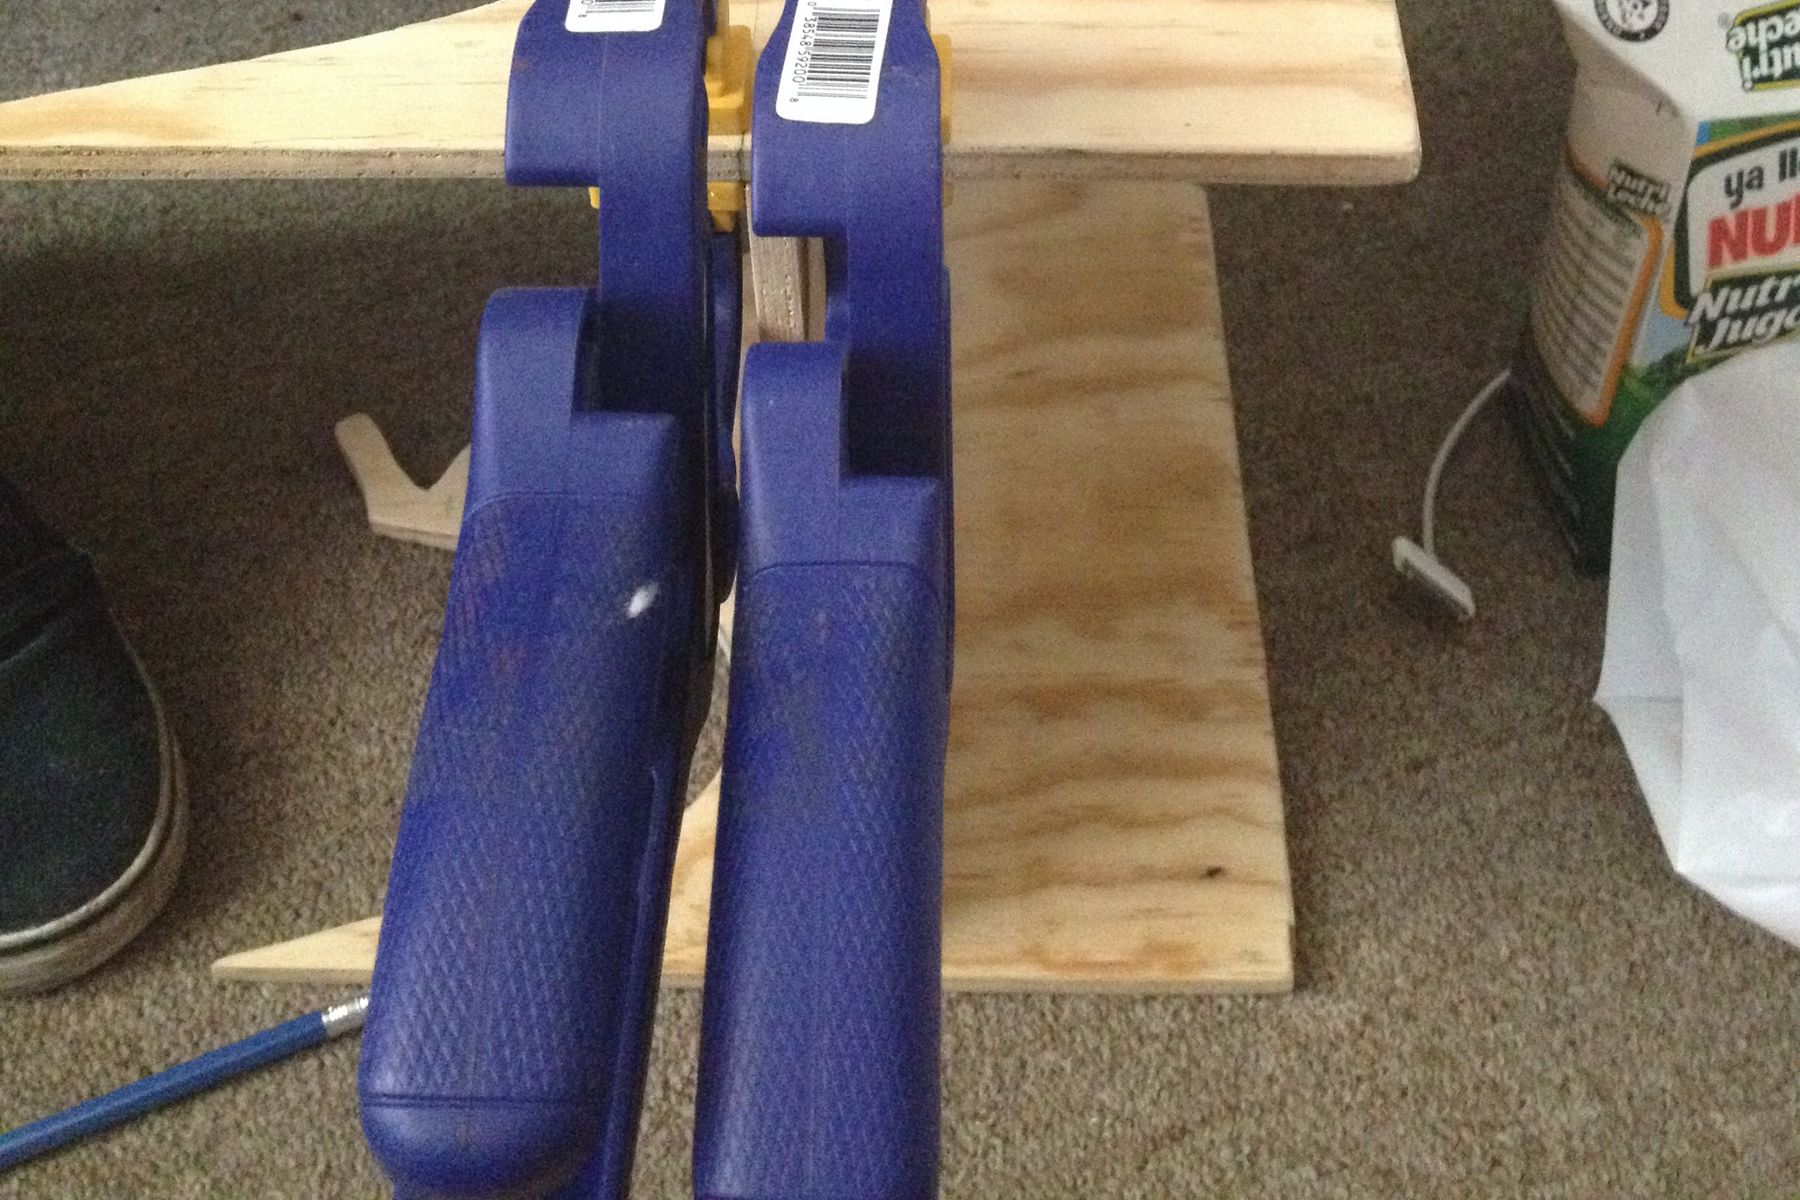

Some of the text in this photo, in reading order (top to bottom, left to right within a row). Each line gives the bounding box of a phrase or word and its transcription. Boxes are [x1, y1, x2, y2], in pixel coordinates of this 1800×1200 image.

[800, 16, 818, 47] 38548
[1726, 11, 1800, 53] eche
[792, 50, 812, 84] 59200
[1742, 42, 1800, 90] utri
[1724, 146, 1800, 209] ya ll
[1708, 193, 1800, 269] NU
[1688, 275, 1800, 324] Nutr
